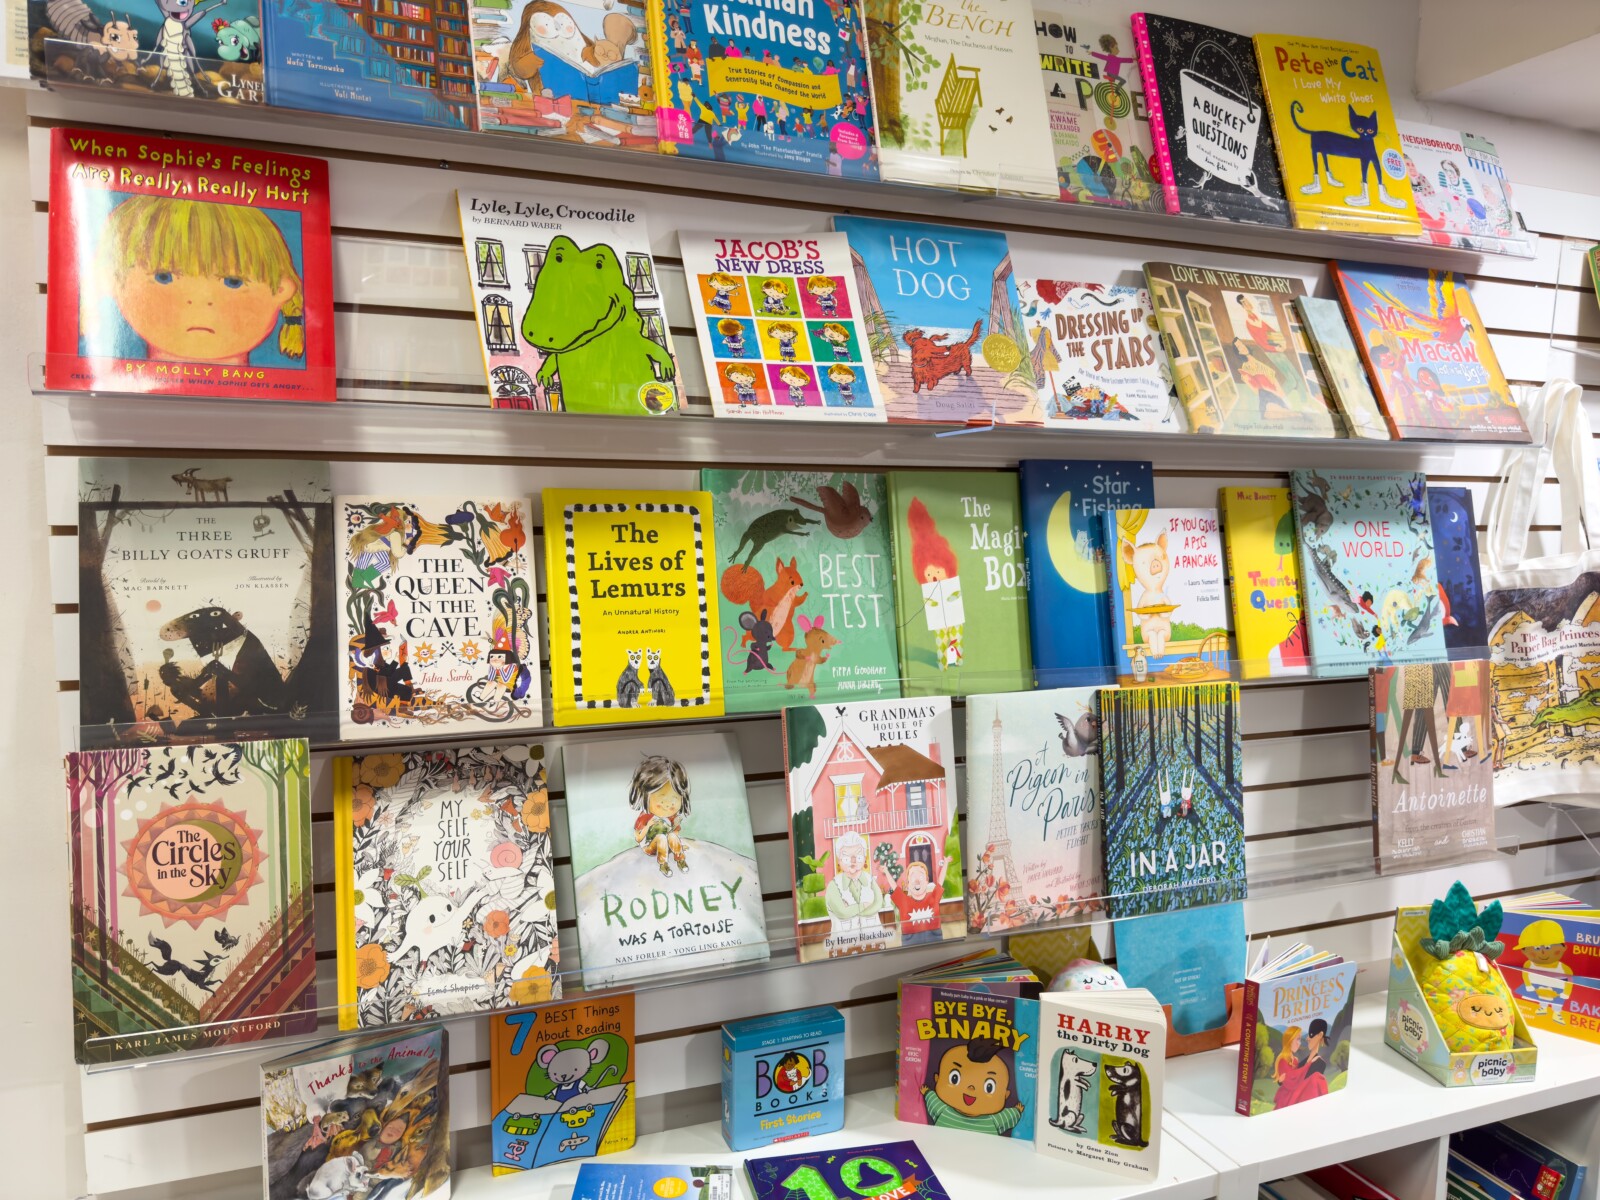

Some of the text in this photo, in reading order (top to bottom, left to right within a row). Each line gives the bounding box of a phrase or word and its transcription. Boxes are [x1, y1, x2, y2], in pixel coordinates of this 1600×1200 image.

[703, 4, 831, 55] Kindness
[925, 3, 1016, 38] BENCH
[1034, 20, 1077, 43] HOW
[924, 34, 949, 45] Meghan,
[1065, 44, 1074, 55] TO
[307, 59, 344, 74] Tarnowska
[1040, 54, 1093, 78] WRITE
[1274, 46, 1378, 83] Pete the Cat
[728, 66, 821, 91] True Stories of Compassion and
[760, 79, 773, 88] that
[1301, 78, 1341, 90] Love My
[1319, 92, 1374, 104] White Shoes
[1050, 114, 1078, 126] KWAME
[1193, 96, 1246, 133] A BUCKET
[1192, 118, 1248, 160] QUESTIONS
[1402, 134, 1463, 153] NEIGHBORHOOD
[70, 137, 311, 188] When Sophie's Feelings
[71, 163, 311, 208] Are Really, Really Hurt
[470, 198, 635, 224] Lyle, Lyle, Crocodile
[472, 216, 562, 231] by BERNARD WABER
[714, 238, 821, 261] JACOB'S
[890, 234, 963, 269] HOT
[715, 258, 825, 276] NEW DRESS
[892, 268, 972, 301] DOG
[1170, 264, 1293, 294] LOVE IN THE LIBRARY
[1055, 307, 1144, 341] DRESSING UP
[1373, 304, 1410, 332] Mr
[1067, 334, 1156, 372] THE STARS
[1399, 336, 1479, 364] Macaw
[125, 362, 266, 379] BY MOLLY BANG
[1092, 475, 1131, 495] Star
[960, 496, 991, 518] The
[196, 517, 217, 525] THE
[1168, 517, 1217, 533] IF YOU GIVE
[1353, 520, 1391, 538] ONE
[176, 531, 233, 541] THREE
[611, 522, 659, 544] The
[1191, 535, 1207, 550] PIG
[122, 548, 291, 561] BILLY GOATS GRUFF
[588, 549, 687, 572] Lives of
[1182, 553, 1217, 568] PANCAKE
[1342, 541, 1404, 558] WORLD
[418, 558, 464, 574] THE
[819, 553, 880, 589] BEST
[395, 574, 486, 602] QUEEN
[590, 578, 686, 599] Lemurs
[410, 599, 476, 614] IN THE
[603, 607, 680, 617] An Unnatural History
[822, 593, 884, 629] TEST
[405, 616, 483, 639] CAVE
[854, 665, 887, 676] GOODHART
[859, 705, 936, 723] GRANDMA'S
[873, 720, 923, 731] HOUSE OF
[879, 731, 918, 742] RULES
[440, 799, 463, 820] MY
[1391, 783, 1486, 814] Antoinette
[1037, 786, 1099, 842] Paris
[177, 829, 201, 844] The
[152, 837, 237, 867] Circles
[433, 837, 472, 862] YOUR
[1130, 840, 1227, 877] IN A JAR
[158, 863, 233, 890] in the Sky
[437, 858, 470, 882] SELF
[1143, 881, 1180, 893] DEBORAH
[600, 876, 742, 929] RODNEY
[618, 918, 734, 947] WAS A TORTOISE
[825, 929, 895, 949] By Henry Blackshaw
[674, 945, 697, 955] YONG
[1572, 945, 1600, 957] BUIL
[1298, 974, 1319, 984] THE
[1272, 972, 1344, 1018] PRINCESS
[1280, 994, 1330, 1019] BRIDE
[544, 1004, 620, 1025] BEST Things
[933, 1001, 1012, 1028] BYE BYE,
[1402, 1014, 1423, 1034] picnic
[1569, 1014, 1600, 1032] BRE
[115, 1019, 282, 1051] KARL JAMES MOUNTFORD
[504, 1011, 538, 1056] 7
[536, 1021, 621, 1044] About Reading
[761, 1033, 802, 1047] STAGE STARTING
[916, 1017, 1030, 1053] BINARY
[1056, 1013, 1151, 1046] HARRY
[1404, 1023, 1422, 1041] baby
[1056, 1028, 1151, 1059] the Dirty Dog
[1241, 1028, 1253, 1083] COUNTING STORY
[1478, 1057, 1507, 1070] picnic
[307, 1045, 436, 1095] Thanks Animals
[755, 1049, 829, 1100] BOB
[1481, 1067, 1506, 1078] baby
[755, 1089, 828, 1112] BOOKS
[760, 1117, 785, 1131] First
[786, 1111, 822, 1124] Stories
[1076, 1143, 1118, 1158] by Zion
[1076, 1150, 1149, 1173] Margaret Graham
